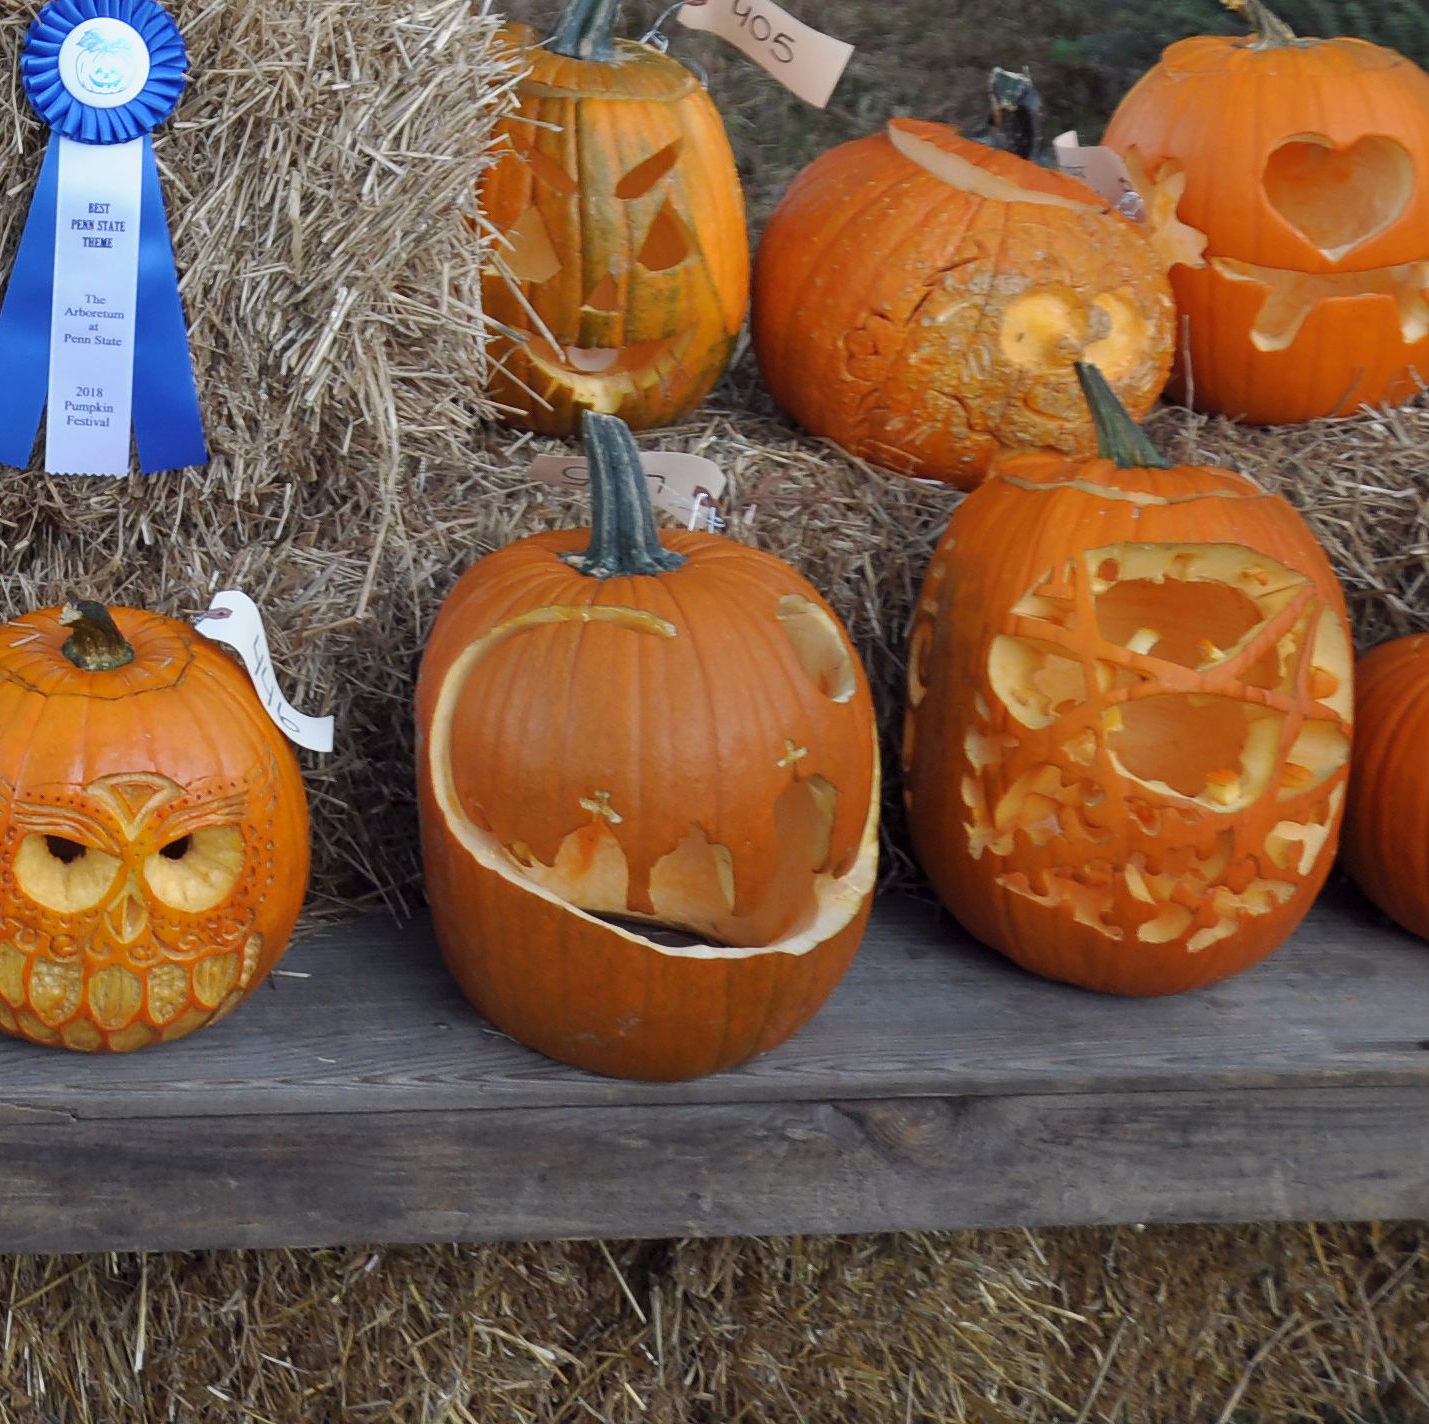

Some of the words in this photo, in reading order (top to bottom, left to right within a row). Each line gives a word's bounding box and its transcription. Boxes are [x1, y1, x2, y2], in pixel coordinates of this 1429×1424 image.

[87, 202, 111, 215] BEST
[70, 219, 95, 231] PENN
[97, 220, 126, 232] STATE
[81, 236, 113, 248] THEME
[84, 293, 106, 305] The
[63, 306, 125, 320] Arboretum
[87, 322, 99, 332] at
[63, 333, 92, 345] Penn
[94, 334, 123, 347] State
[75, 386, 104, 398] 2018
[64, 400, 114, 414] Pumpkin
[66, 414, 110, 428] Festival
[253, 635, 301, 734] 446
